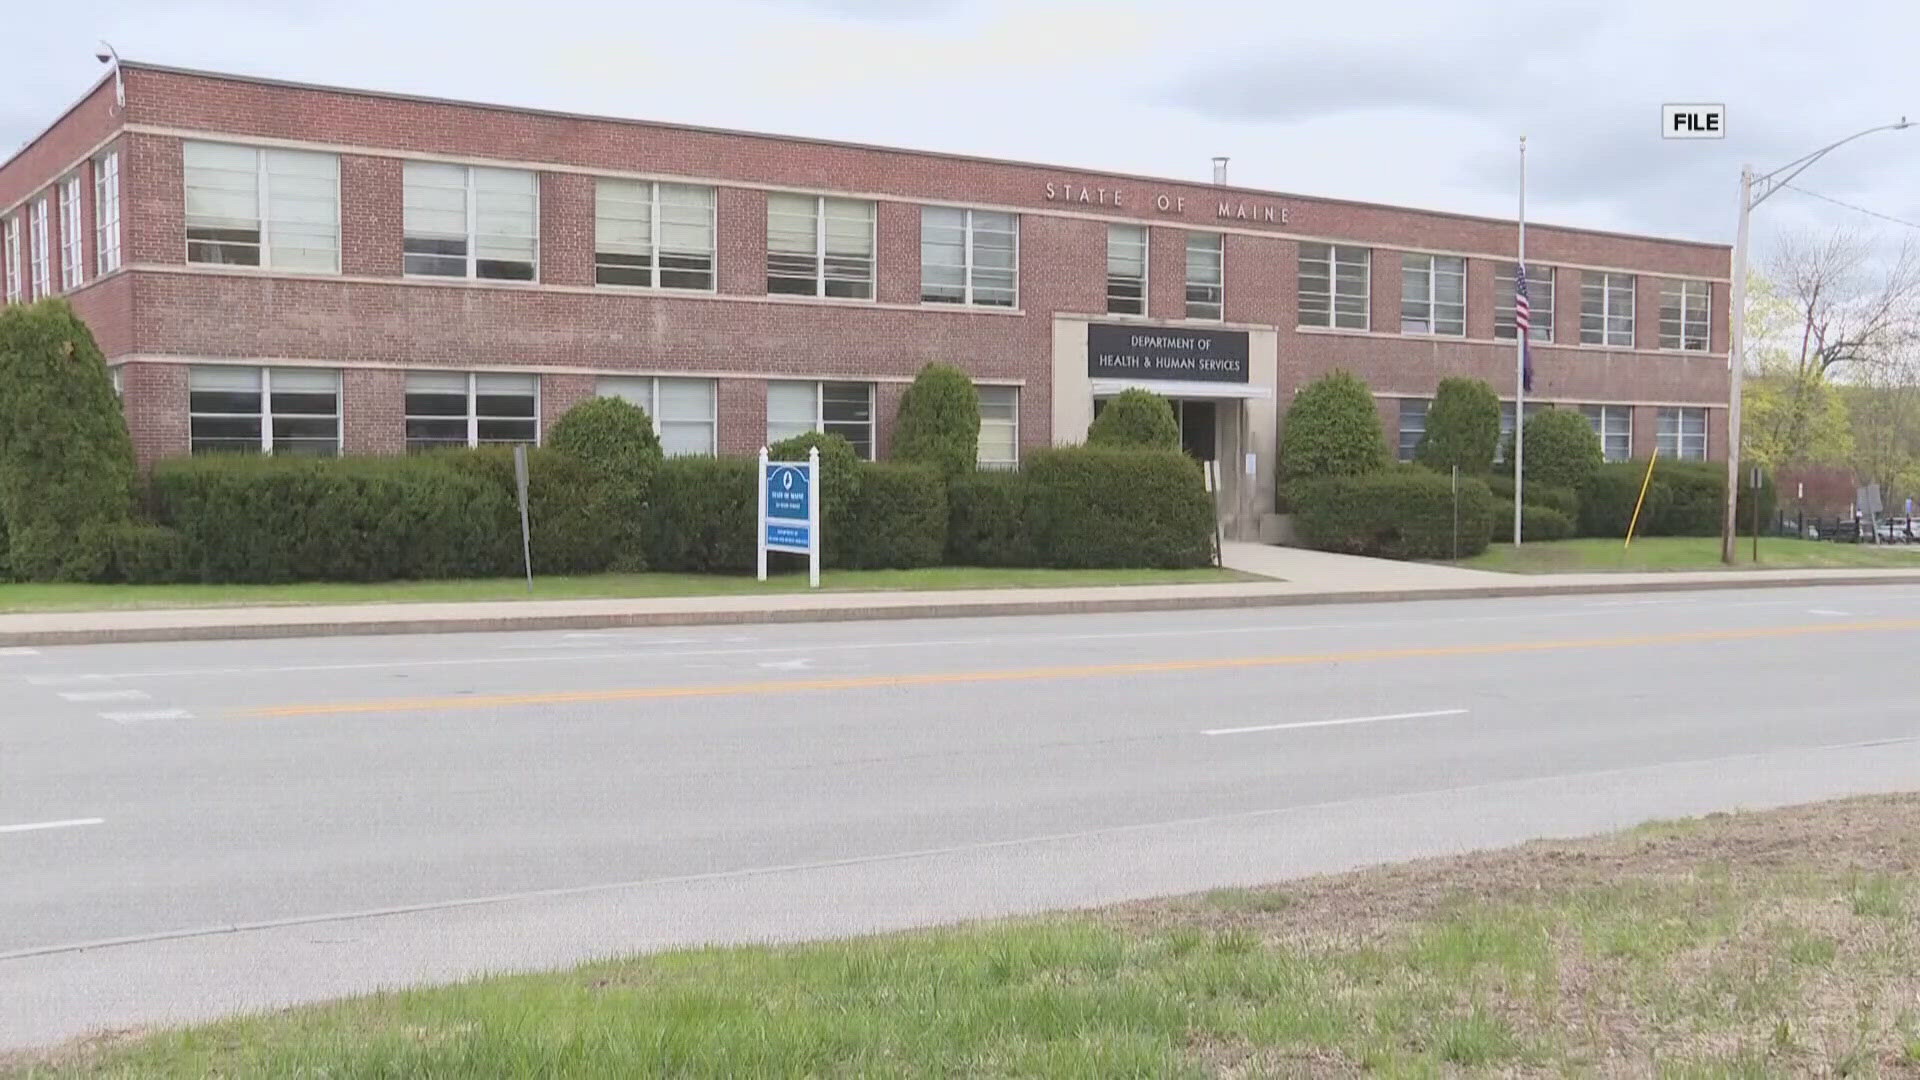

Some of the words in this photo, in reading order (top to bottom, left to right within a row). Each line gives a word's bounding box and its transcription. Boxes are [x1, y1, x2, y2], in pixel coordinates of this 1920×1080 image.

[1046, 182, 1122, 206] STATE
[1157, 194, 1185, 212] OF
[1218, 202, 1290, 224] MAINE
[1131, 335, 1195, 350] DEPARTMENT
[1198, 339, 1212, 351] OF
[1099, 354, 1140, 368] HEALTH
[1143, 357, 1151, 369] &
[1156, 357, 1195, 370] HUMAN
[1199, 358, 1240, 372] SERVICES
